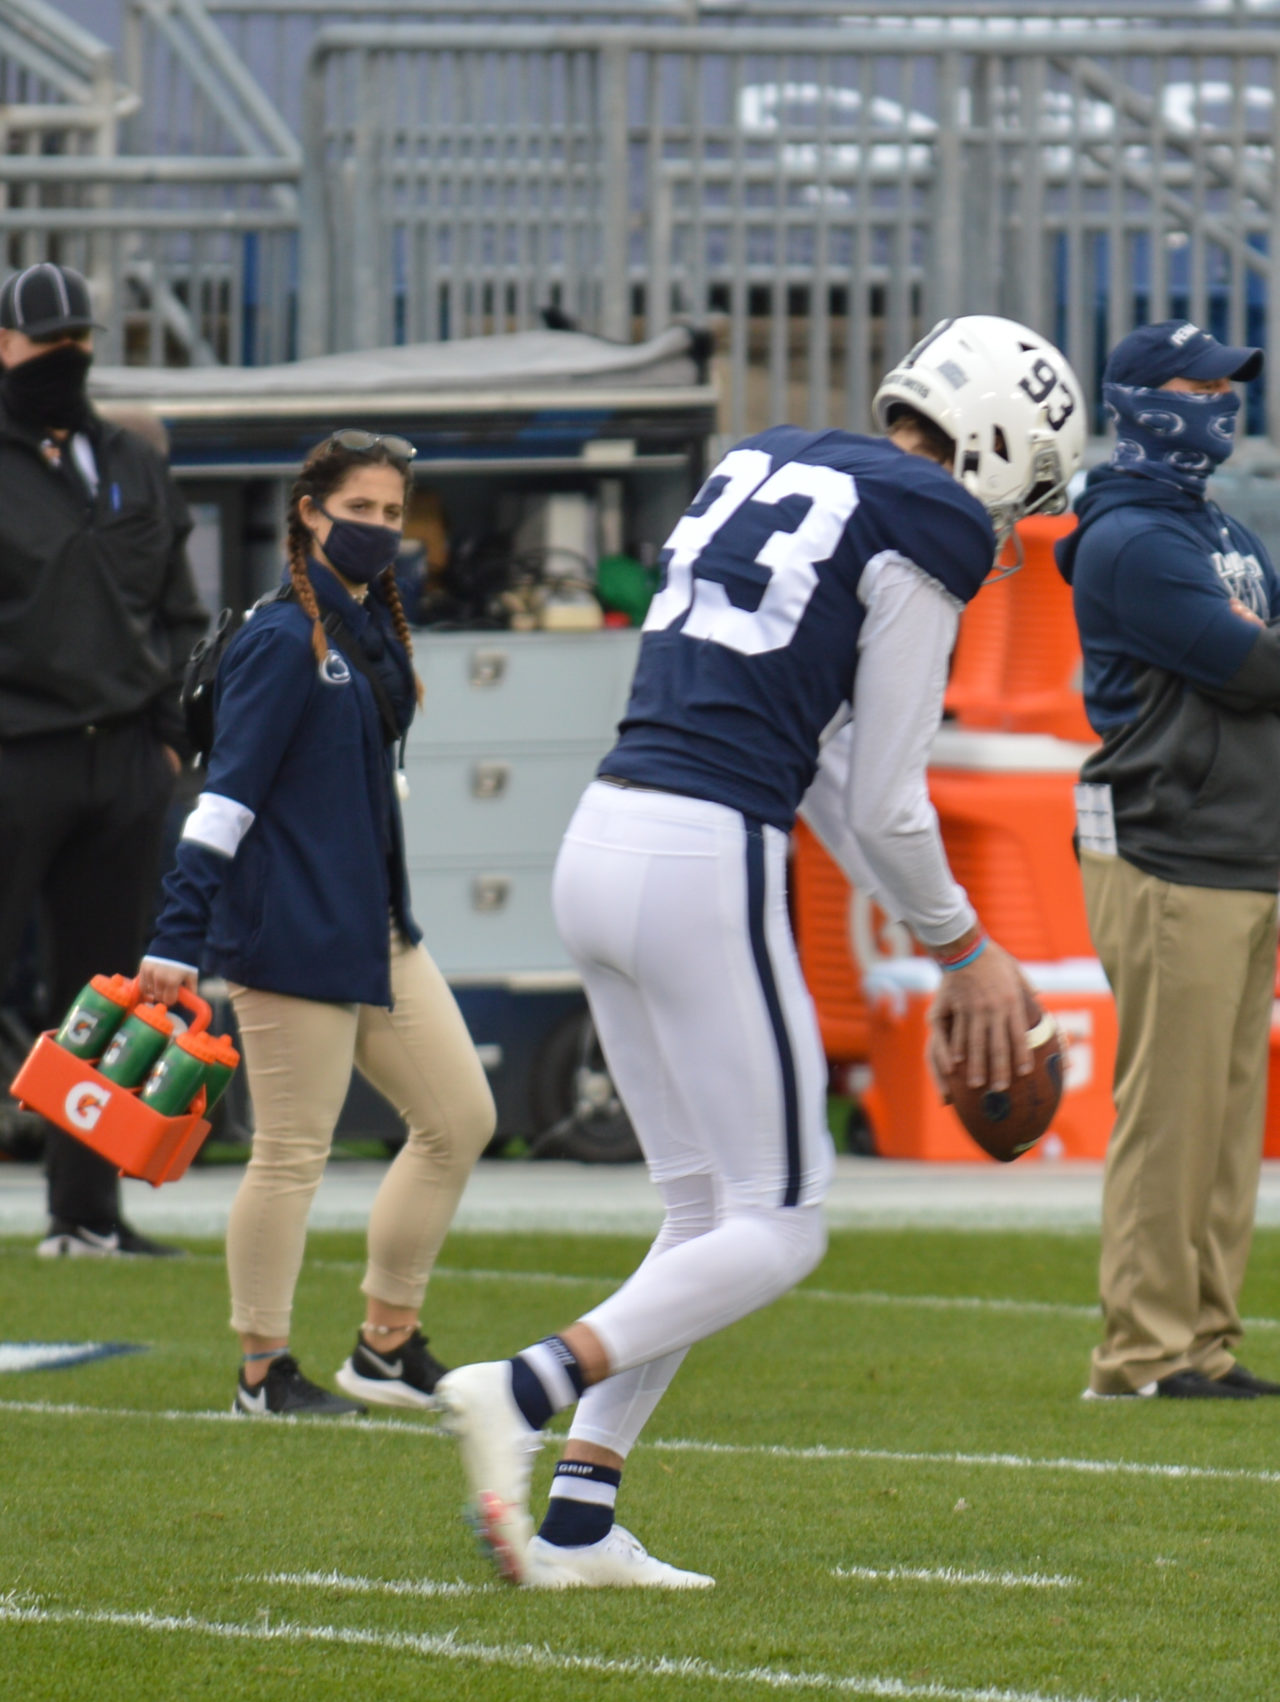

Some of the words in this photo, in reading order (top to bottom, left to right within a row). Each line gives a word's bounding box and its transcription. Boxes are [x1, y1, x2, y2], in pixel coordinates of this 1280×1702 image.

[1018, 357, 1074, 431] 93
[640, 447, 860, 656] 93
[67, 1010, 99, 1046] G
[65, 1080, 112, 1131] G
[558, 1463, 594, 1475] GRIP
